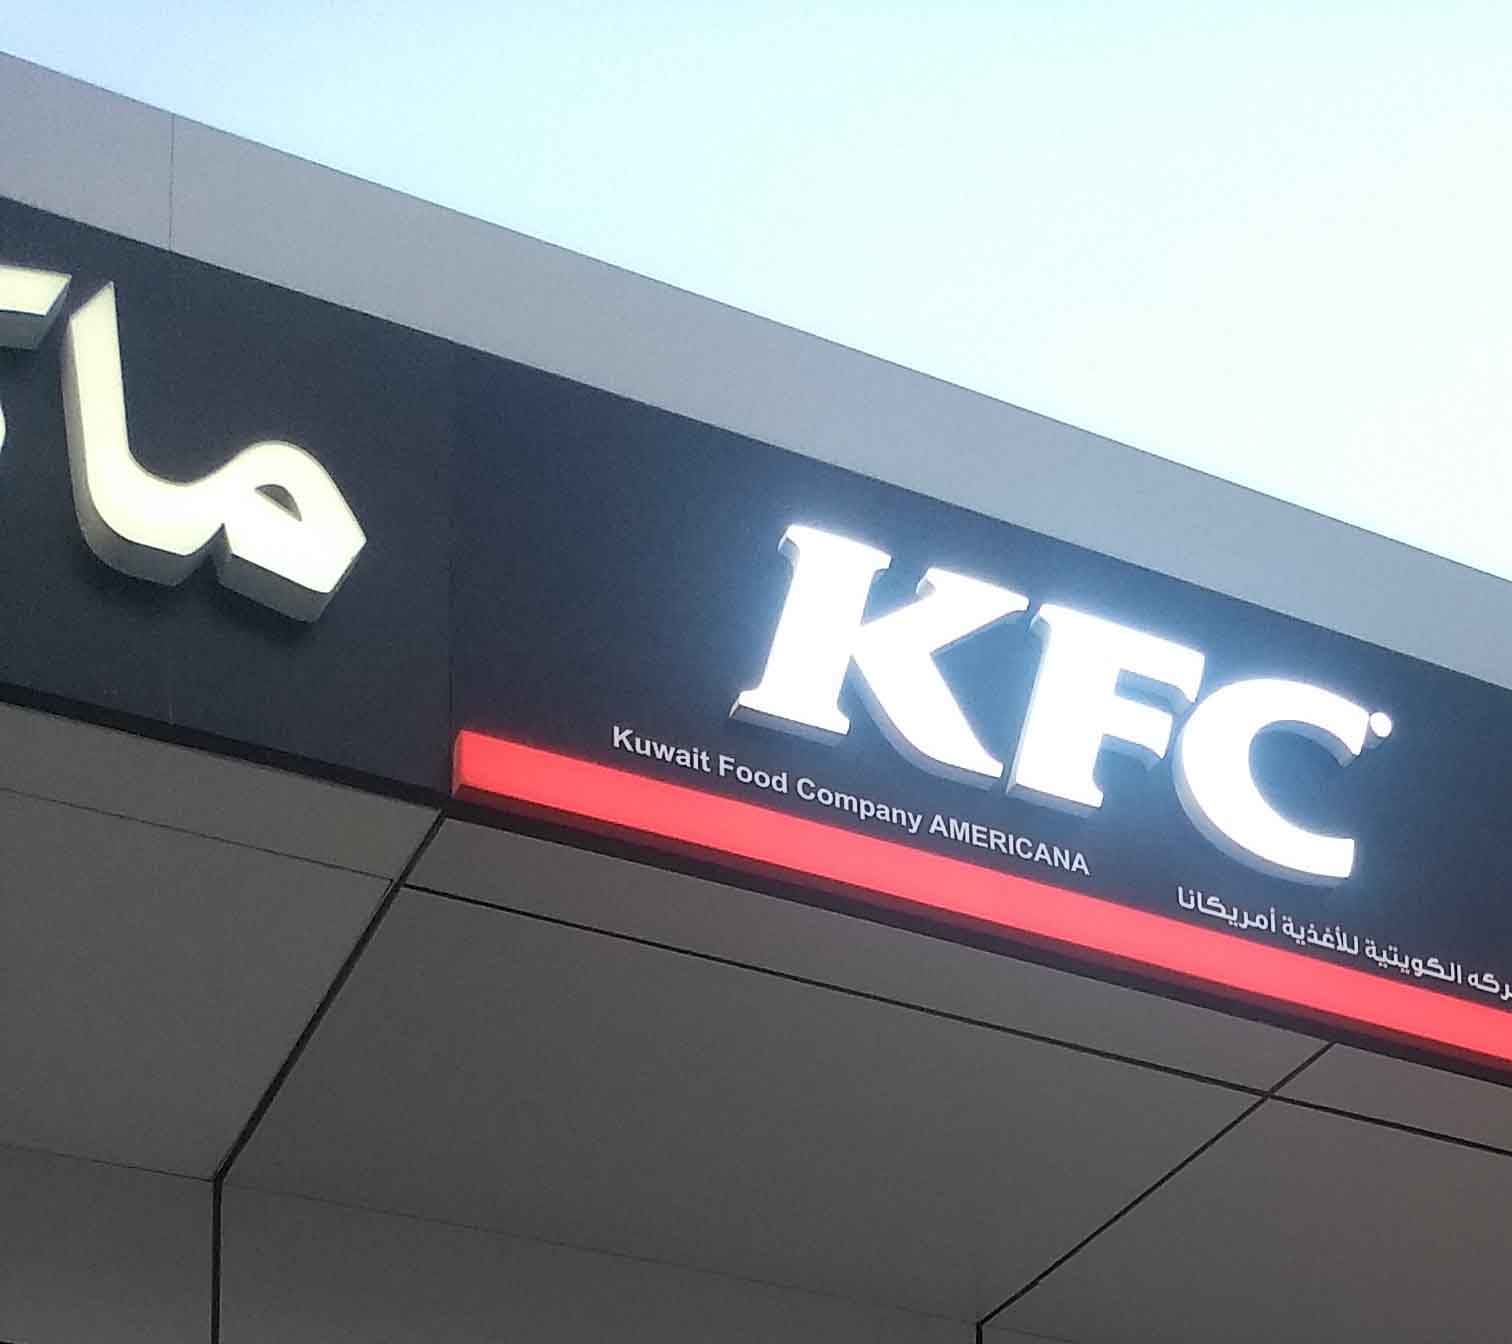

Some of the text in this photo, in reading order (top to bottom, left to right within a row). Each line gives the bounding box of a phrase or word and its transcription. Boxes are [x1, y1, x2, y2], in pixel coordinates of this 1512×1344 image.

[730, 523, 1391, 887] KFC
[612, 725, 1090, 876] Kuwait Food Company AMERICANA
[1176, 886, 1276, 932] أمريكانا
[1282, 915, 1359, 954] للأغذية
[1366, 938, 1462, 984] الكويتية
